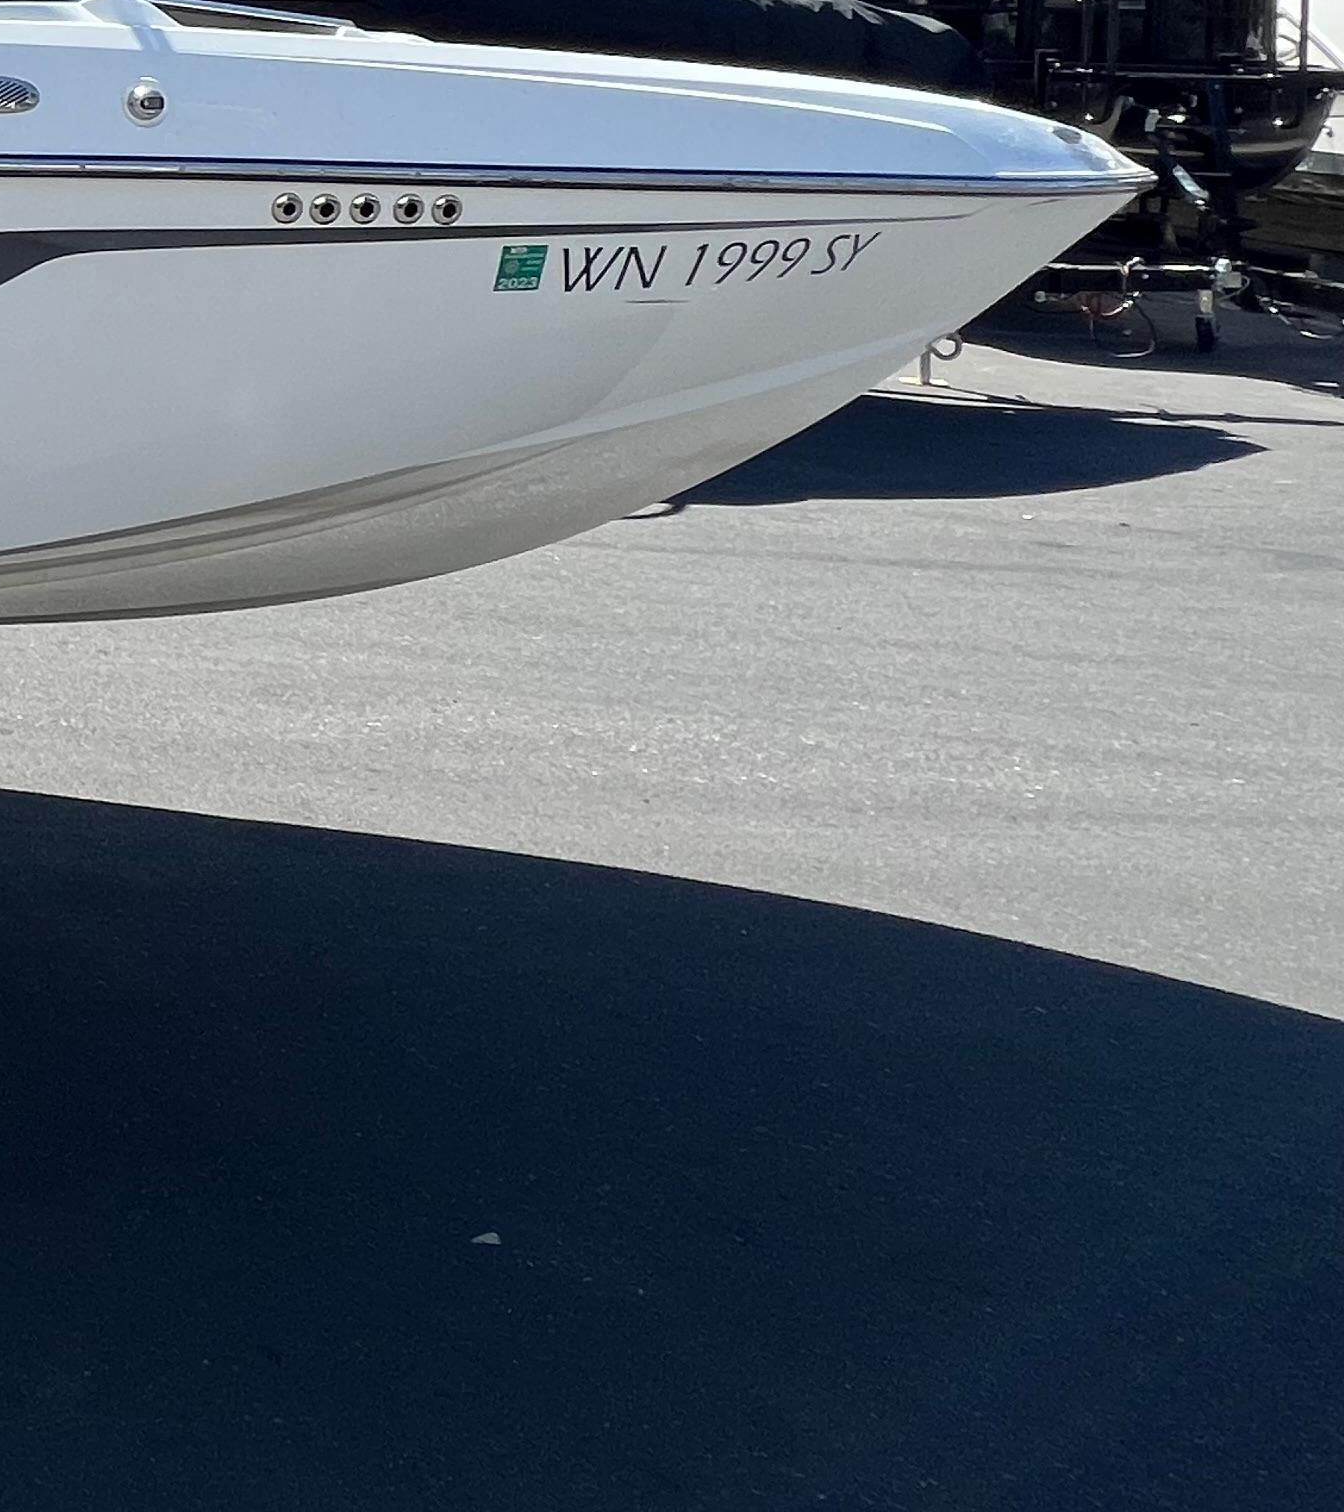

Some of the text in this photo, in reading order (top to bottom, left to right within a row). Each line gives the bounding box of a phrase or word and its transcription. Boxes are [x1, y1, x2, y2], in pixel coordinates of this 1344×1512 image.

[562, 245, 667, 292] WN
[685, 238, 811, 286] 1999
[810, 232, 882, 275] SY
[498, 277, 538, 289] 2023
